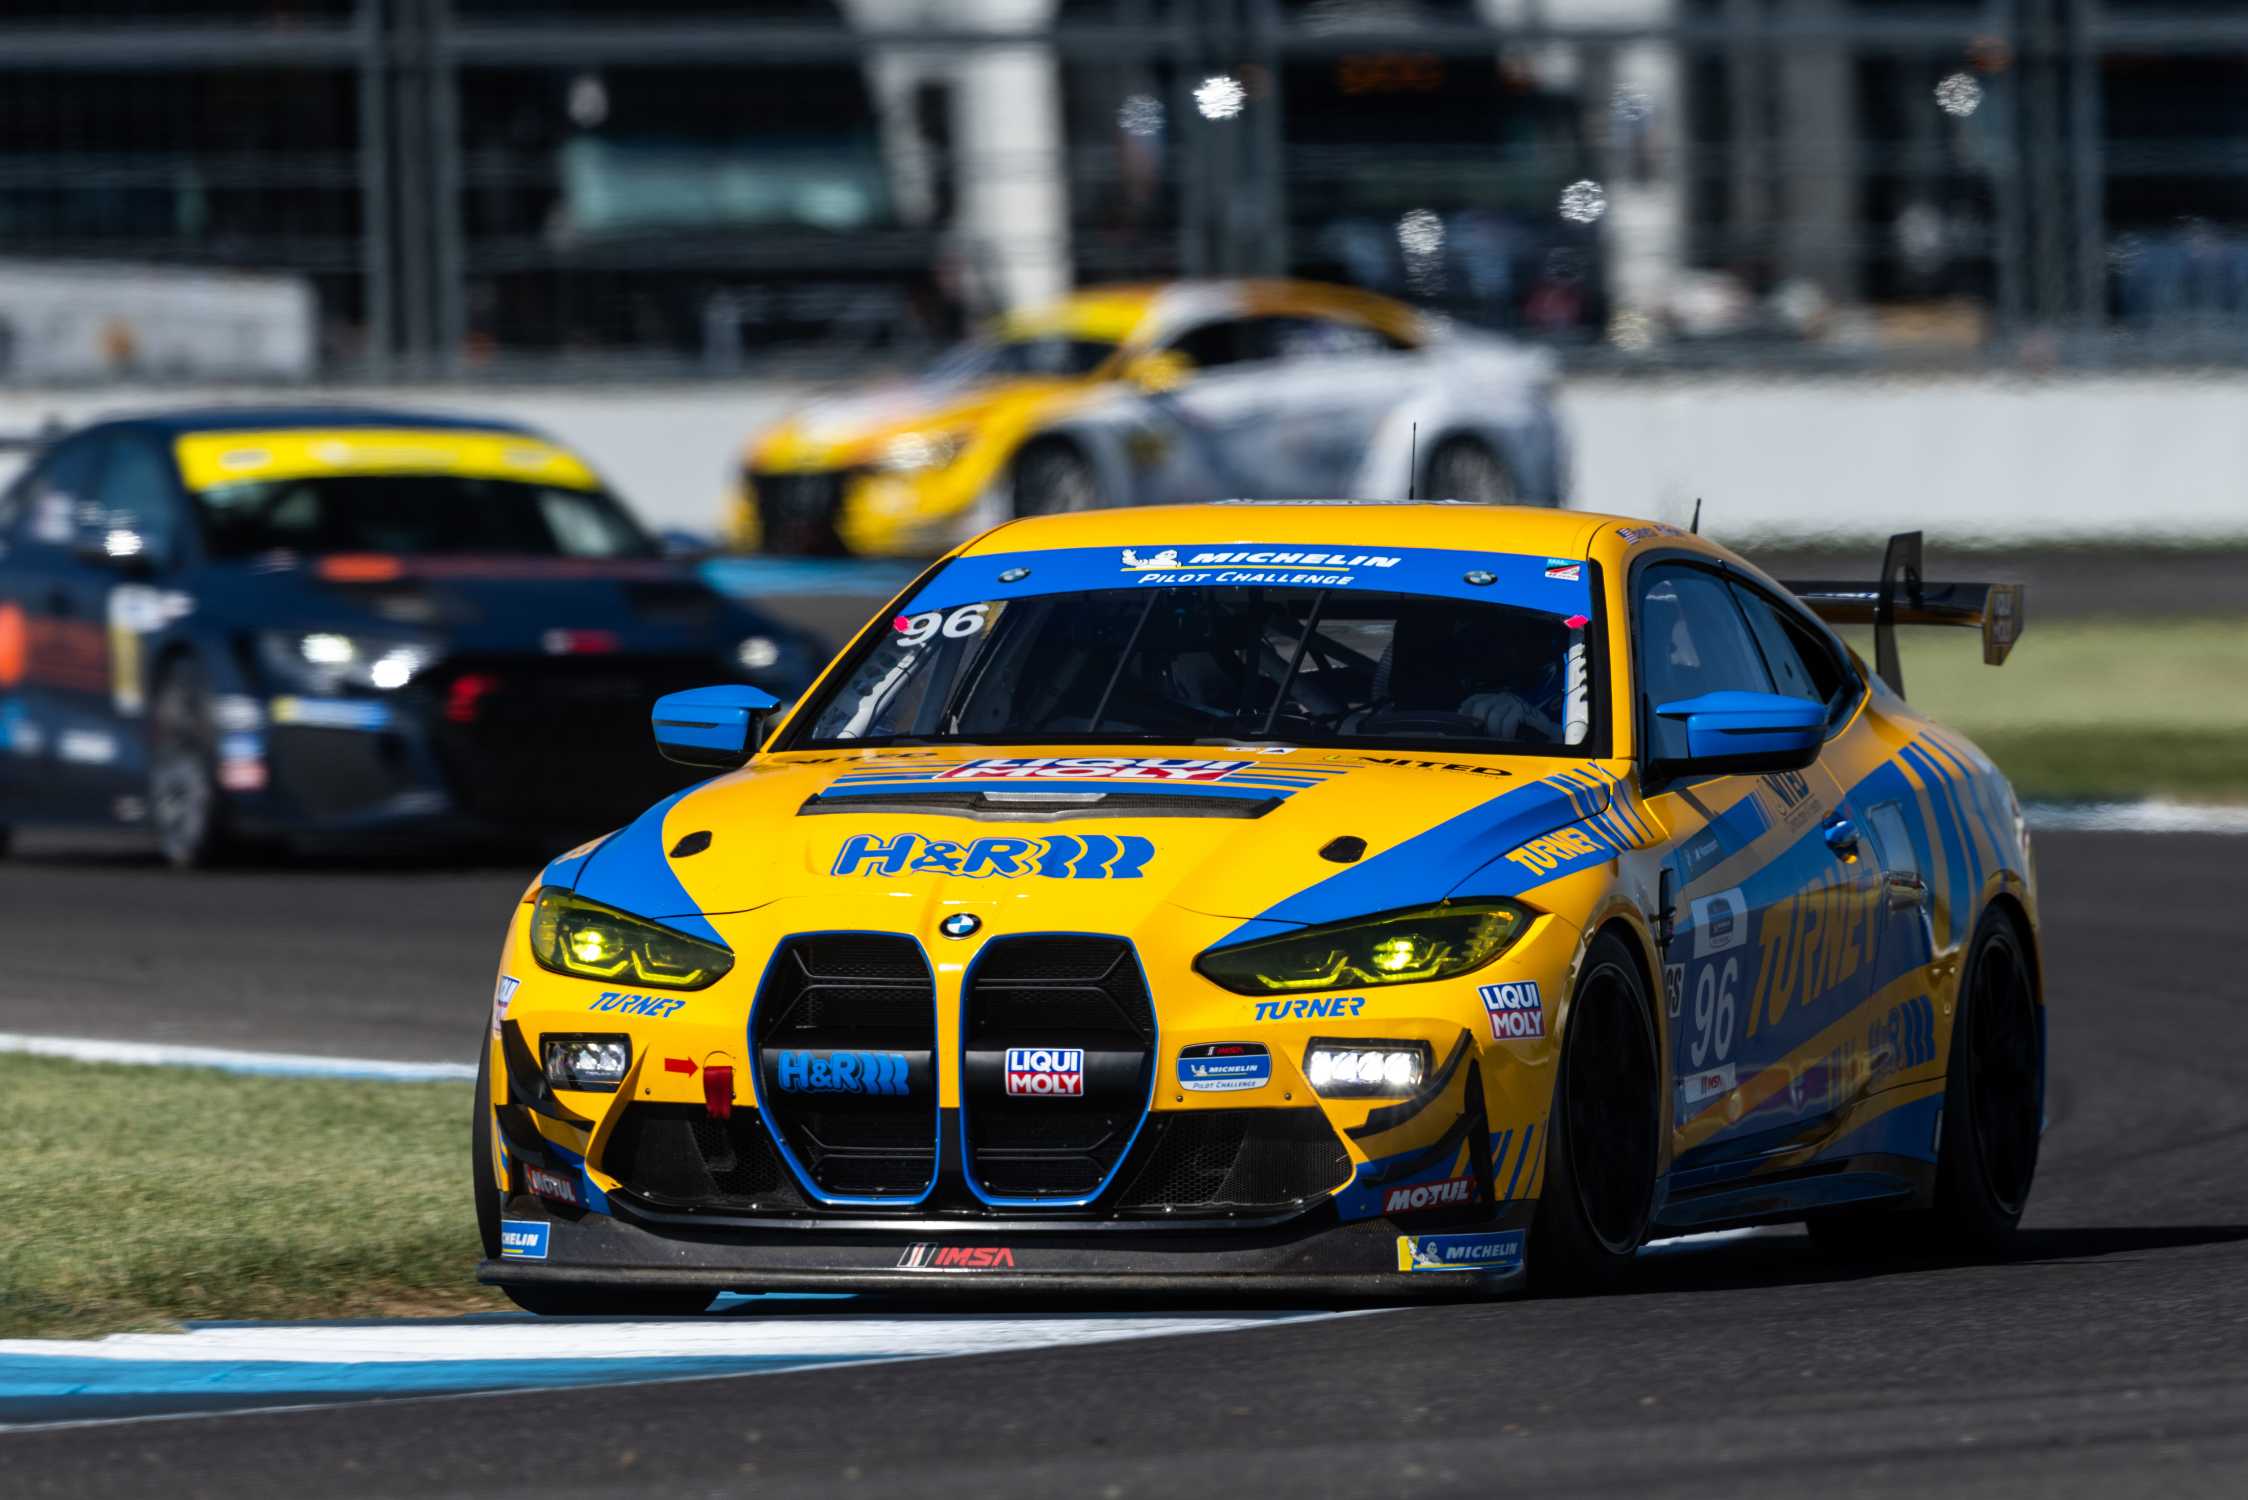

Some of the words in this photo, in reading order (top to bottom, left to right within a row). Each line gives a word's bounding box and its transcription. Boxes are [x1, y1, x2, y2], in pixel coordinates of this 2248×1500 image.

[1189, 552, 1401, 568] MICHELIN
[1138, 573, 1210, 584] PILOT
[1216, 571, 1354, 585] CHALLENGE
[896, 603, 990, 647] 96
[951, 766, 1214, 780] MOLY
[973, 758, 1241, 769] LIQUI
[830, 833, 1043, 880] H&R
[1505, 827, 1606, 876] TURNER
[588, 991, 686, 1018] TURNER
[1481, 983, 1540, 1010] LIQUI
[1255, 997, 1366, 1021] TURNER
[1691, 957, 1739, 1068] 96
[1491, 1010, 1542, 1037] MOLY
[778, 1051, 862, 1093] H&R
[1010, 1050, 1078, 1073] LIQUI
[1208, 1064, 1258, 1073] MICHELIN
[1010, 1073, 1080, 1094] MOLY
[1387, 1180, 1469, 1211] MOTUL
[934, 1246, 1015, 1267] IMSA
[1446, 1242, 1518, 1259] MICHELIN
